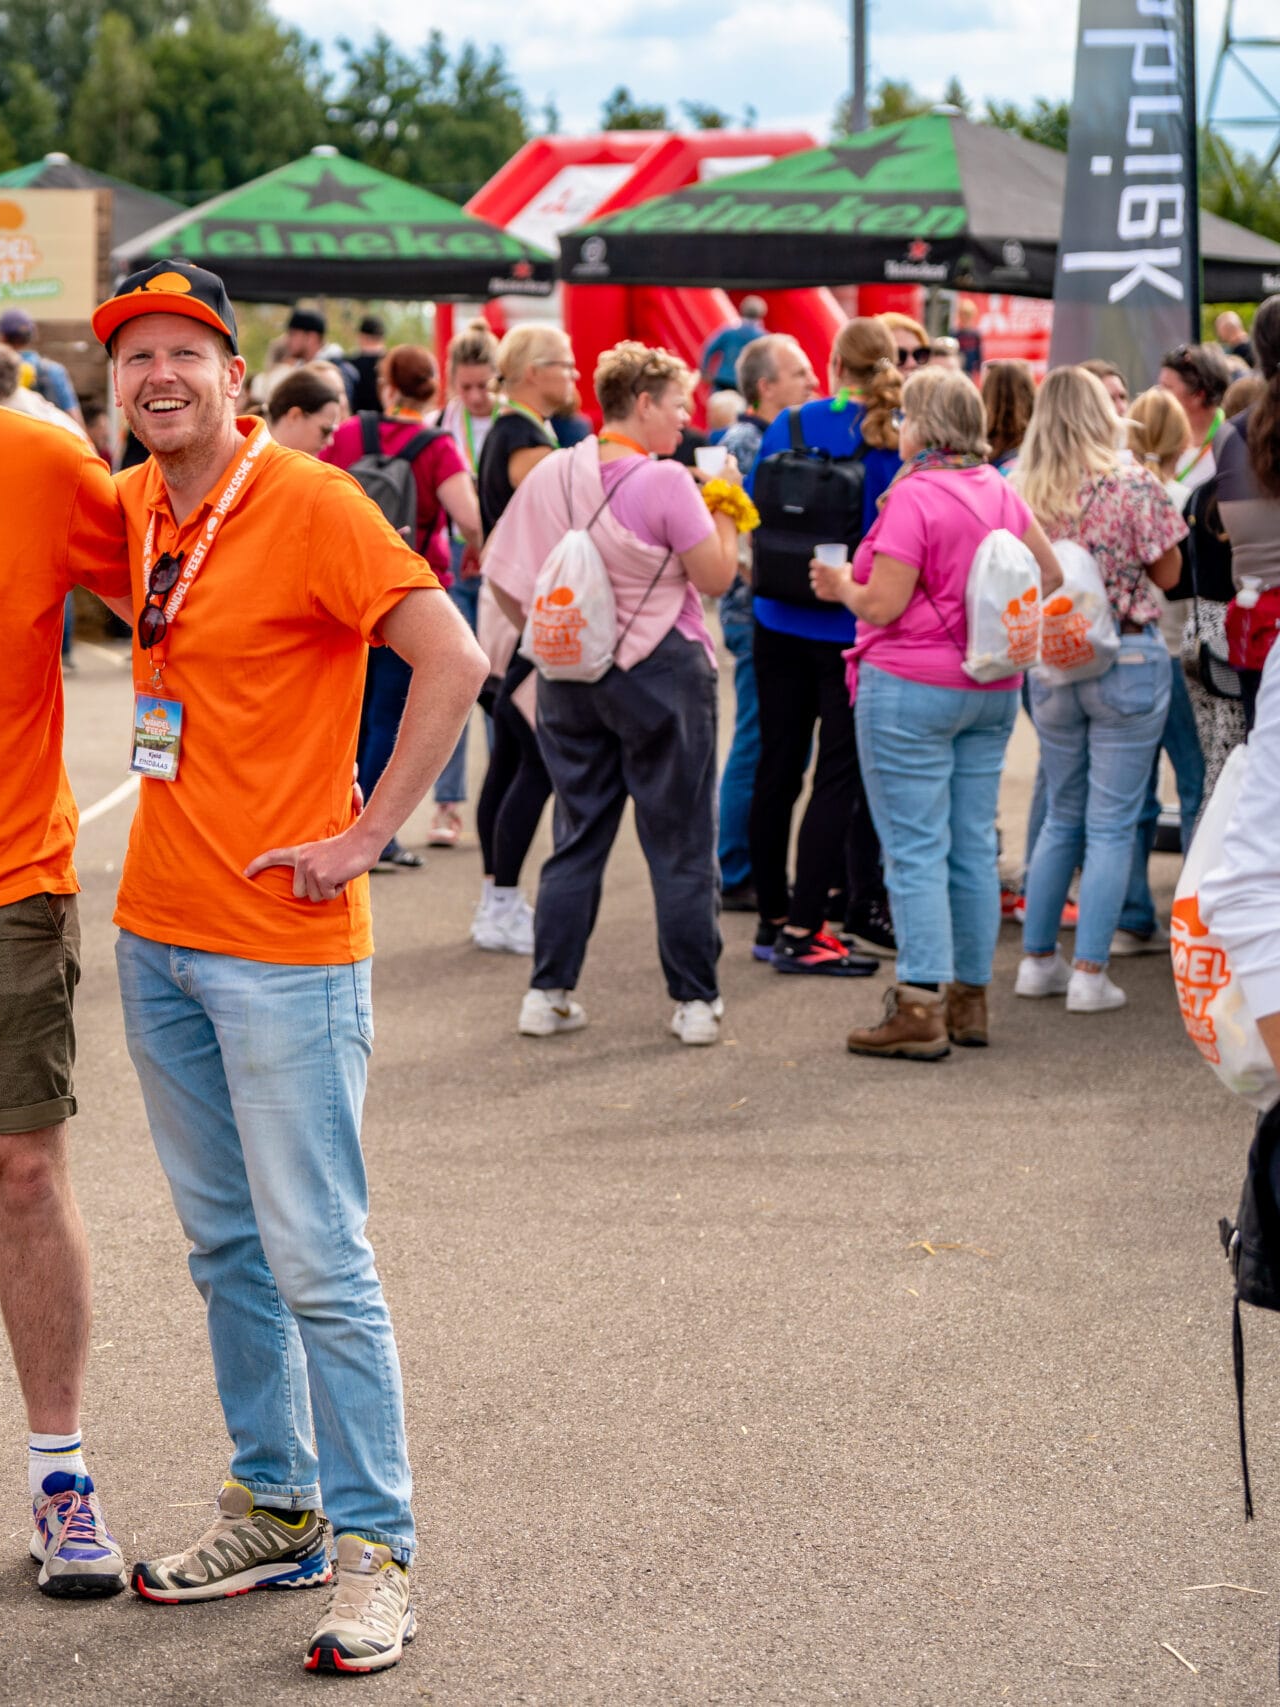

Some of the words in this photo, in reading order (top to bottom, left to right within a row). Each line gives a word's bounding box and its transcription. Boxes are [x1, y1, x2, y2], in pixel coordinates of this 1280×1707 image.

[214, 458, 255, 516] HOEKSCHE
[182, 540, 209, 580] FEEST
[138, 758, 168, 770] EINDBAAS
